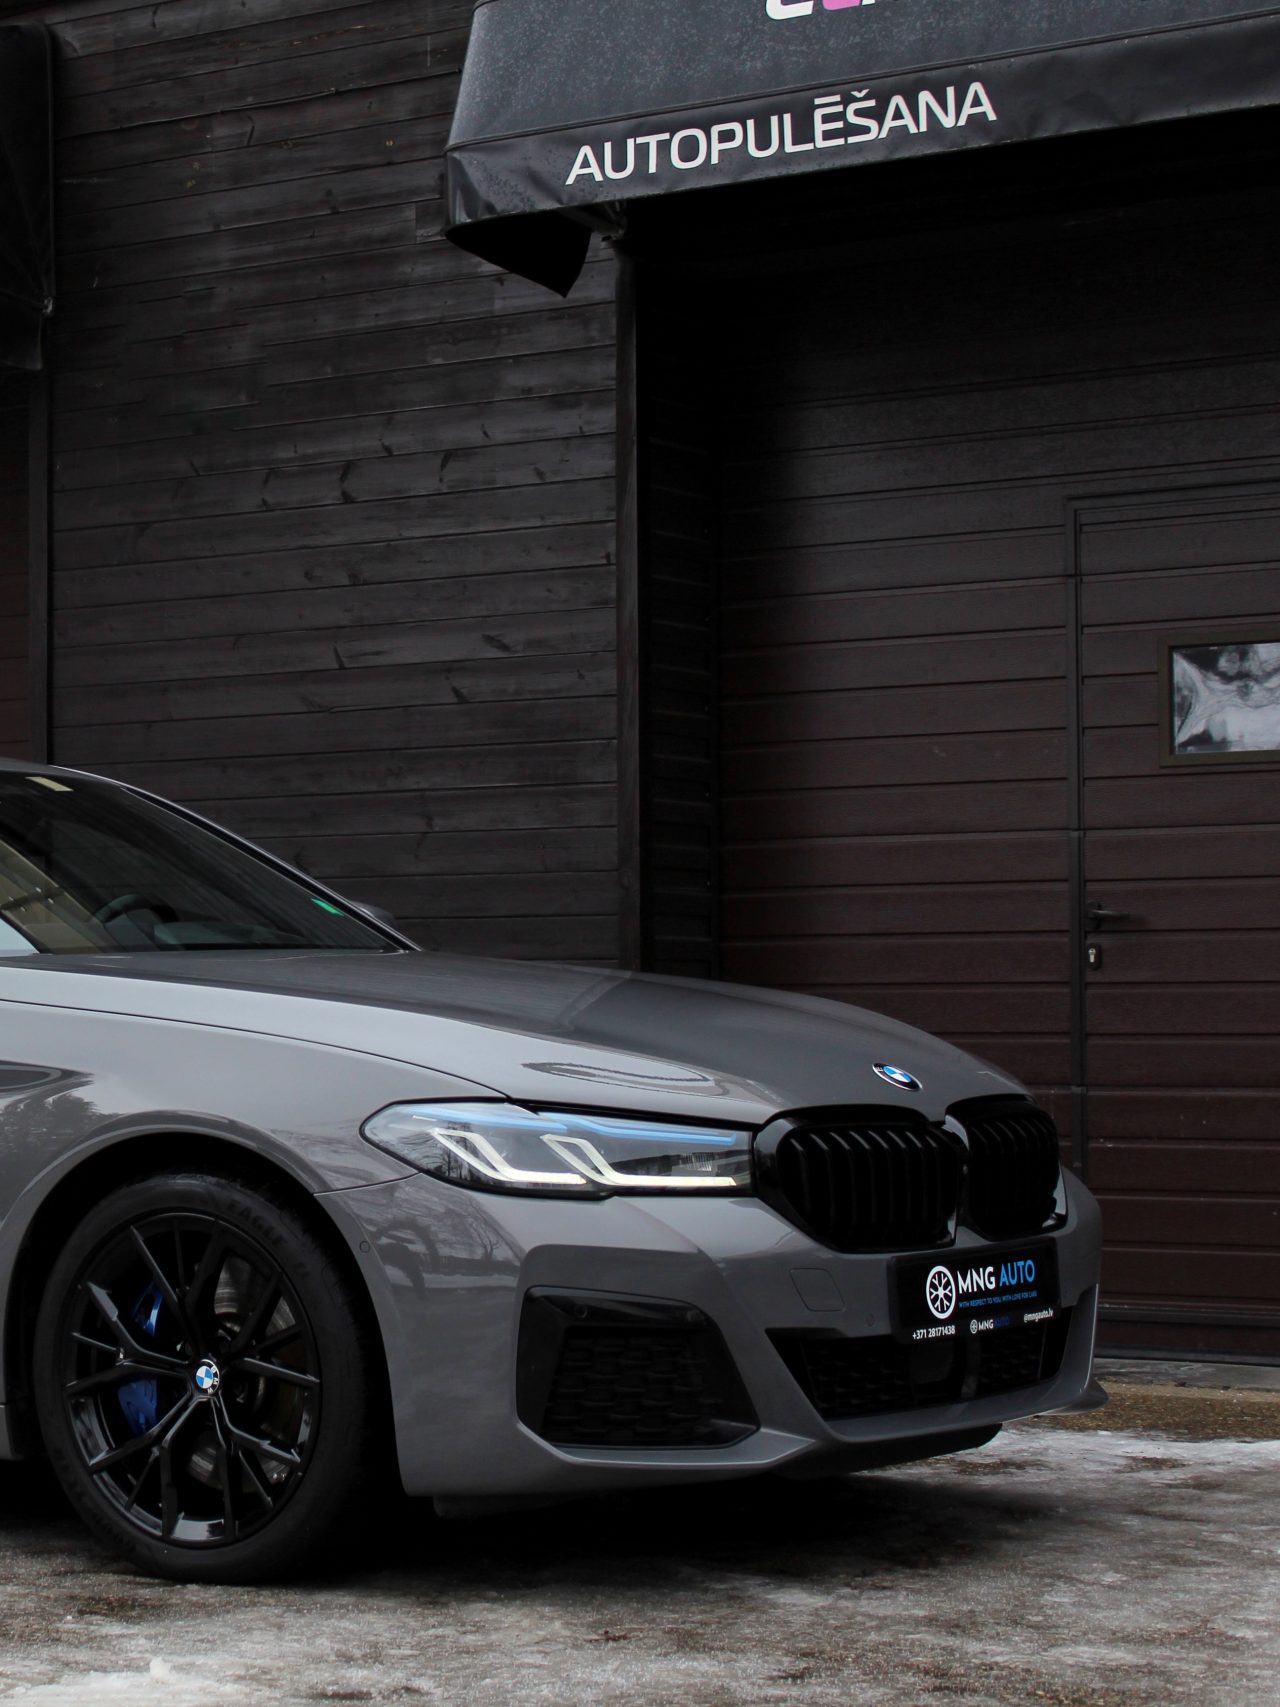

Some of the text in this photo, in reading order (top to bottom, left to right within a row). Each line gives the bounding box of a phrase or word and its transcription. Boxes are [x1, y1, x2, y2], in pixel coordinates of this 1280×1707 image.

[565, 81, 998, 186] AUTOPULĒŠANA
[957, 1259, 1036, 1294] MNG AUTO
[912, 1325, 956, 1340] +371 28171438
[978, 1319, 994, 1331] MNG
